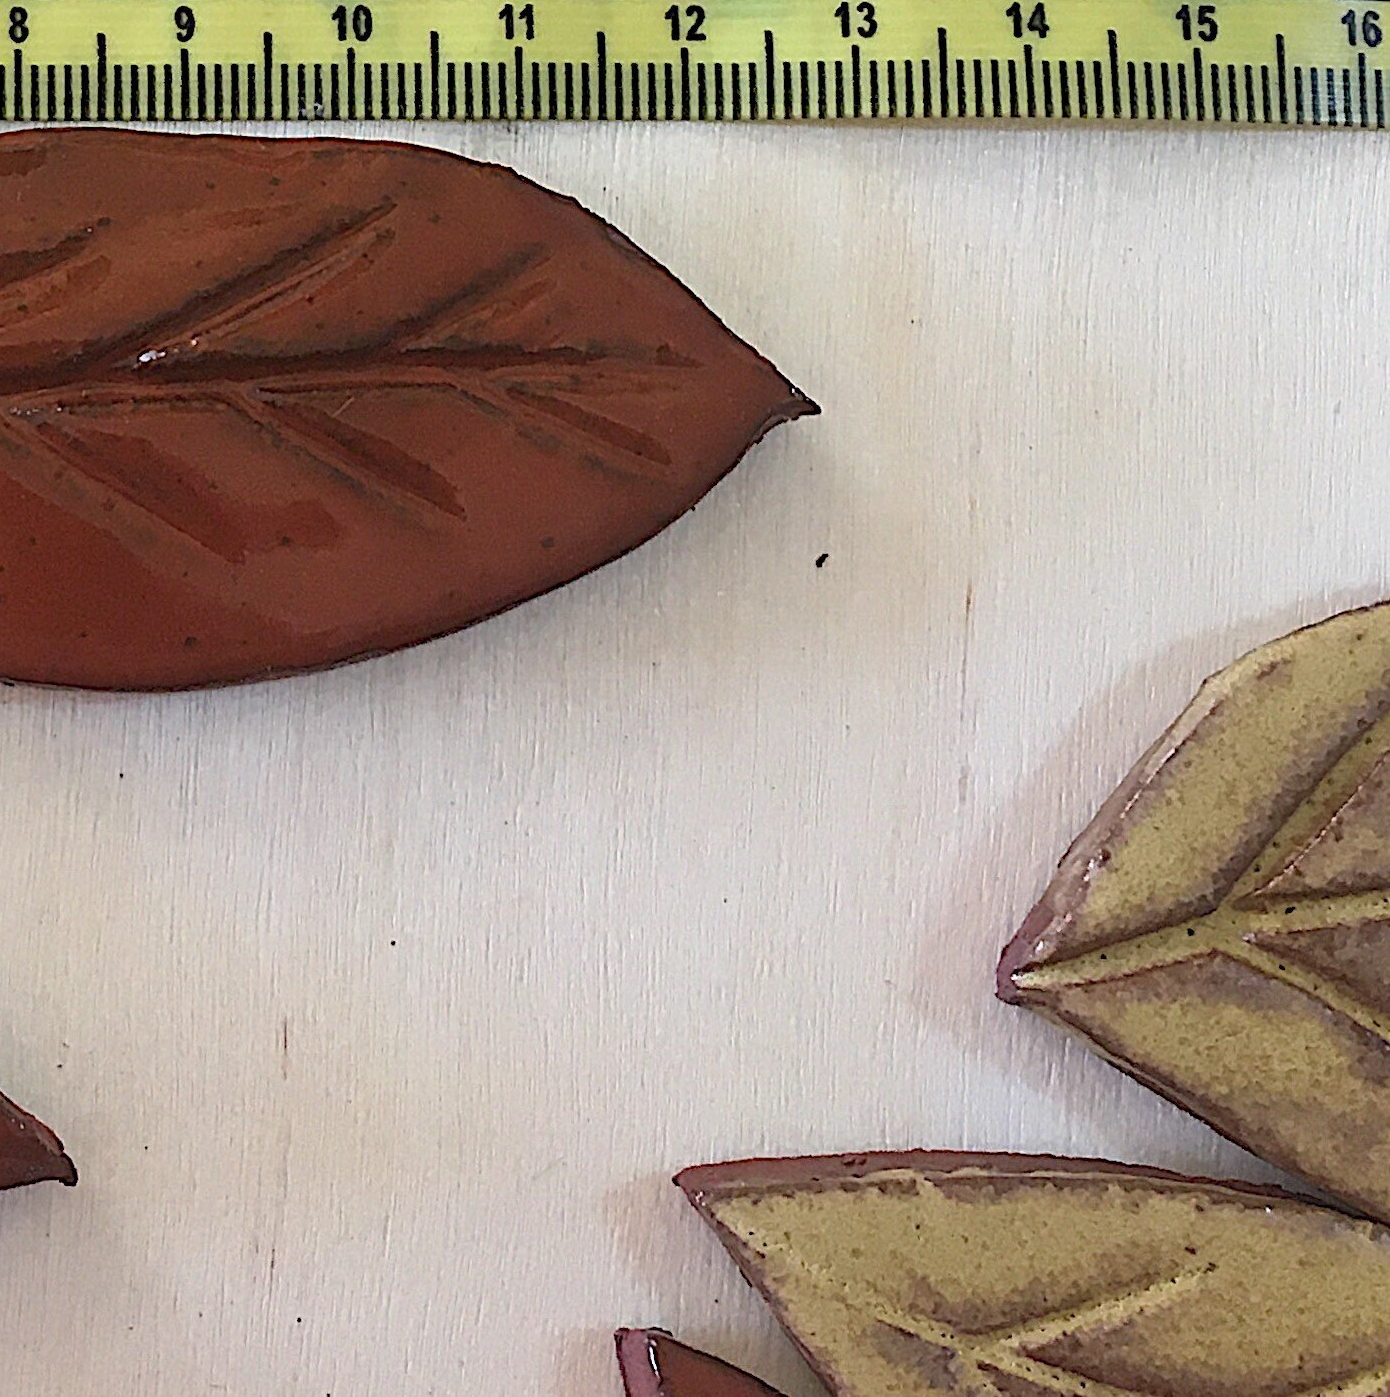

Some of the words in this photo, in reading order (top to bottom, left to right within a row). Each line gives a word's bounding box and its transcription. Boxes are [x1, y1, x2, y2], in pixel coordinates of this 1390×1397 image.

[8, 6, 30, 44] 8
[173, 5, 196, 43] 9
[331, 4, 373, 42] 10
[498, 3, 535, 41] 11
[664, 4, 707, 42] 12
[834, 1, 878, 39] 13
[1005, 1, 1050, 39] 14
[1175, 4, 1219, 43] 15
[1340, 9, 1383, 48] 16
